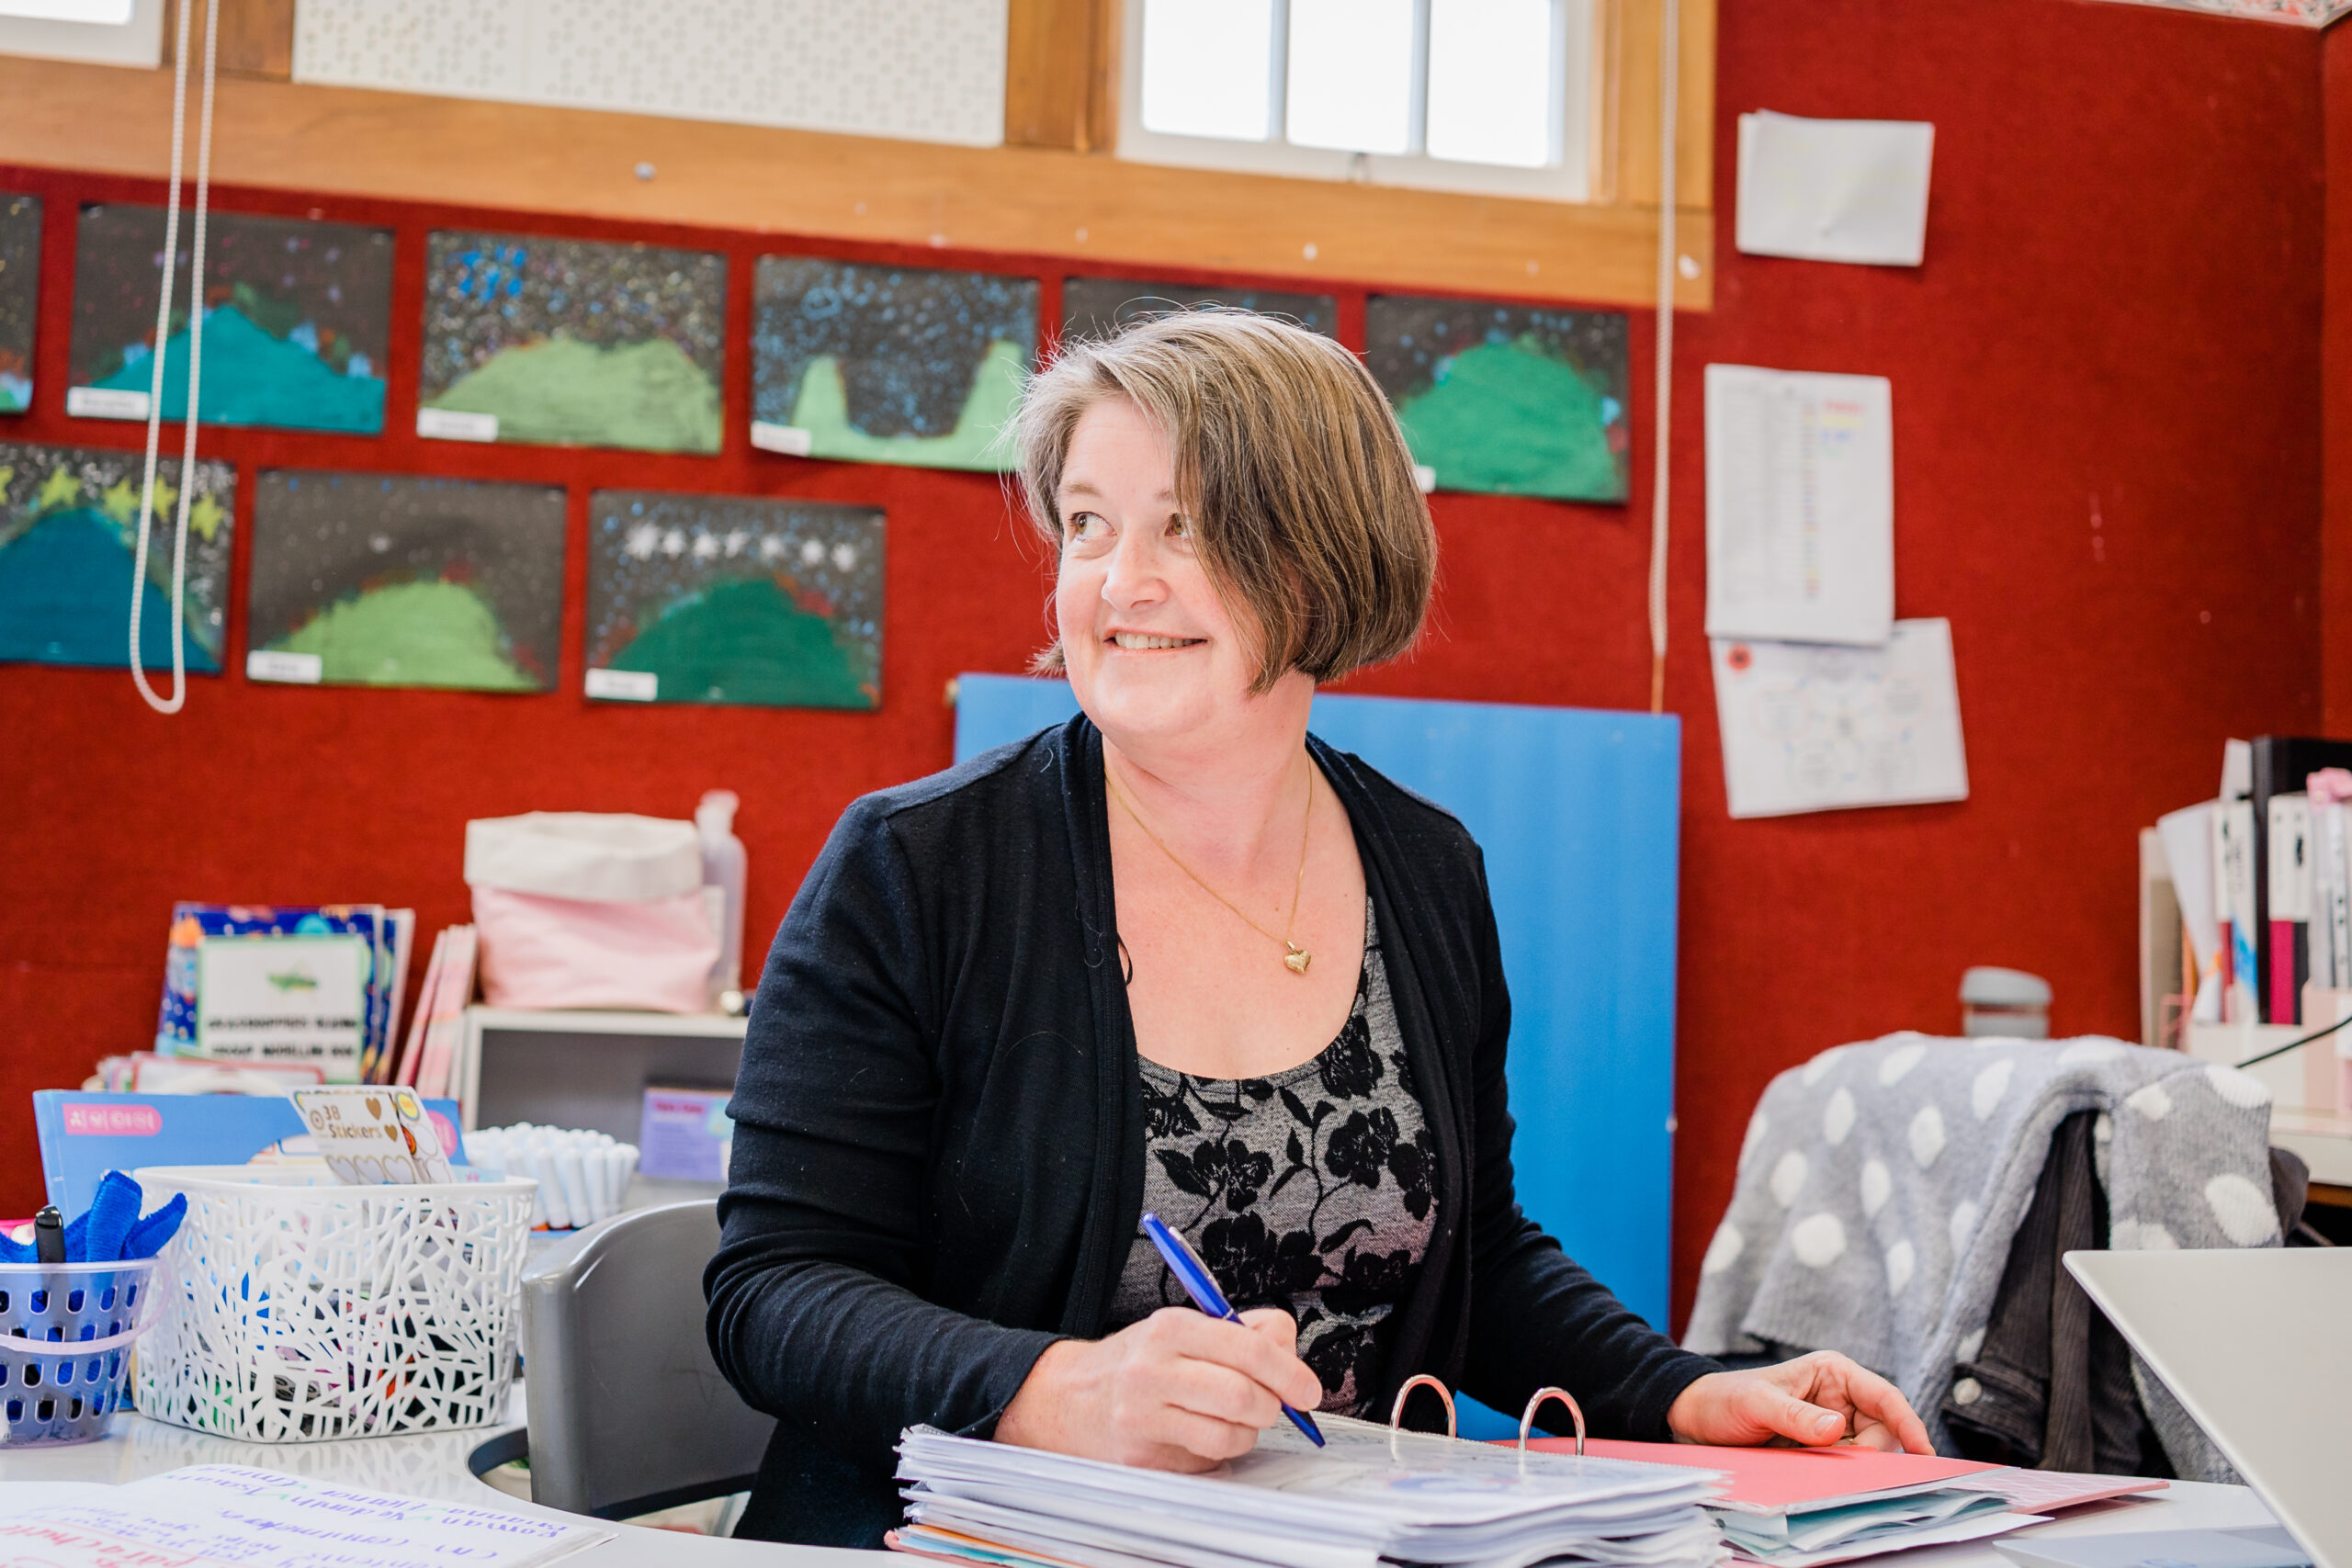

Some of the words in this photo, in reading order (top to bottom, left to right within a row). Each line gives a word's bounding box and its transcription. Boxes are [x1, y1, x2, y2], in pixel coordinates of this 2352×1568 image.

[323, 1105, 342, 1121] 38
[328, 1123, 383, 1140] Stickers
[290, 1495, 405, 1521] Vedanth
[319, 1490, 428, 1512] Eleanor
[440, 1517, 559, 1540] Roman
[447, 1509, 569, 1532] Brianna
